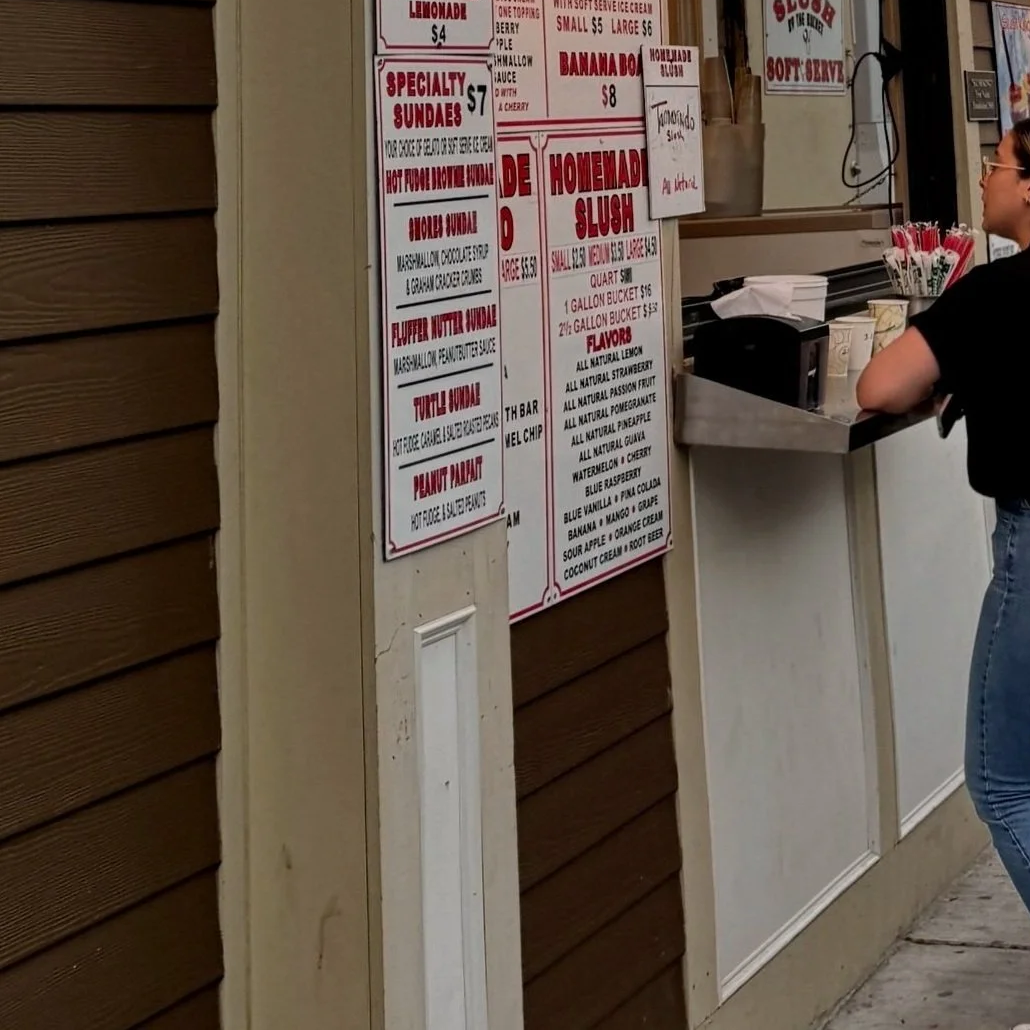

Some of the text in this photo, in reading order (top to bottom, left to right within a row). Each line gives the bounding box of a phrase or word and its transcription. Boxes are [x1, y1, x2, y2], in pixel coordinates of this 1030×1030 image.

[410, 1, 466, 19] LEMONADE
[594, 0, 616, 12] SERVE
[618, 1, 628, 13] ICE
[630, 2, 652, 14] CREAM
[796, 12, 804, 27] THE
[432, 24, 446, 43] $4
[557, 15, 652, 37] SMALL $5 LARGE $6
[559, 51, 618, 77] BANANA
[650, 49, 691, 62] HOMEMADE
[767, 57, 844, 83] SOFT SERVE
[661, 64, 683, 78] SLUSH
[386, 72, 487, 116] SPECIALTY $7
[602, 84, 616, 108] $8
[394, 102, 461, 129] SUNDAES
[386, 163, 493, 194] HOT FUDGE BROWNIE SUNDAE
[409, 211, 478, 242] SMORES SUNDAE
[575, 193, 634, 240] SLUSH
[551, 248, 570, 272] SMALL
[588, 242, 610, 266] MEDIUM
[626, 238, 644, 260] LARGE
[590, 270, 617, 288] QUART
[565, 284, 651, 314] 1 GALLON BUCKET $16
[391, 304, 496, 348] FLUFFER NUTTER SUNDAE
[574, 305, 641, 332] GALLON BUCKET
[587, 327, 632, 353] FLAVORS
[576, 346, 643, 373] ALL NATURAL LEMON
[566, 360, 653, 393] ALL NATURAL STRAWBERRY
[414, 382, 480, 422] TURTLE SUNDAE
[414, 456, 482, 501] PEANUT PARFAIT
[572, 446, 652, 484] WATERMELON CHERRY
[585, 467, 641, 497] BLUE RASPBERRY
[564, 477, 661, 524] BLUE VANILLA PINA COLADA
[568, 495, 658, 541] BANANA MANGO GRAPE
[563, 510, 663, 562] SOUR APPLE ORANGE CREAM
[564, 528, 663, 580] COCONUT CREAM ROOT BEER
